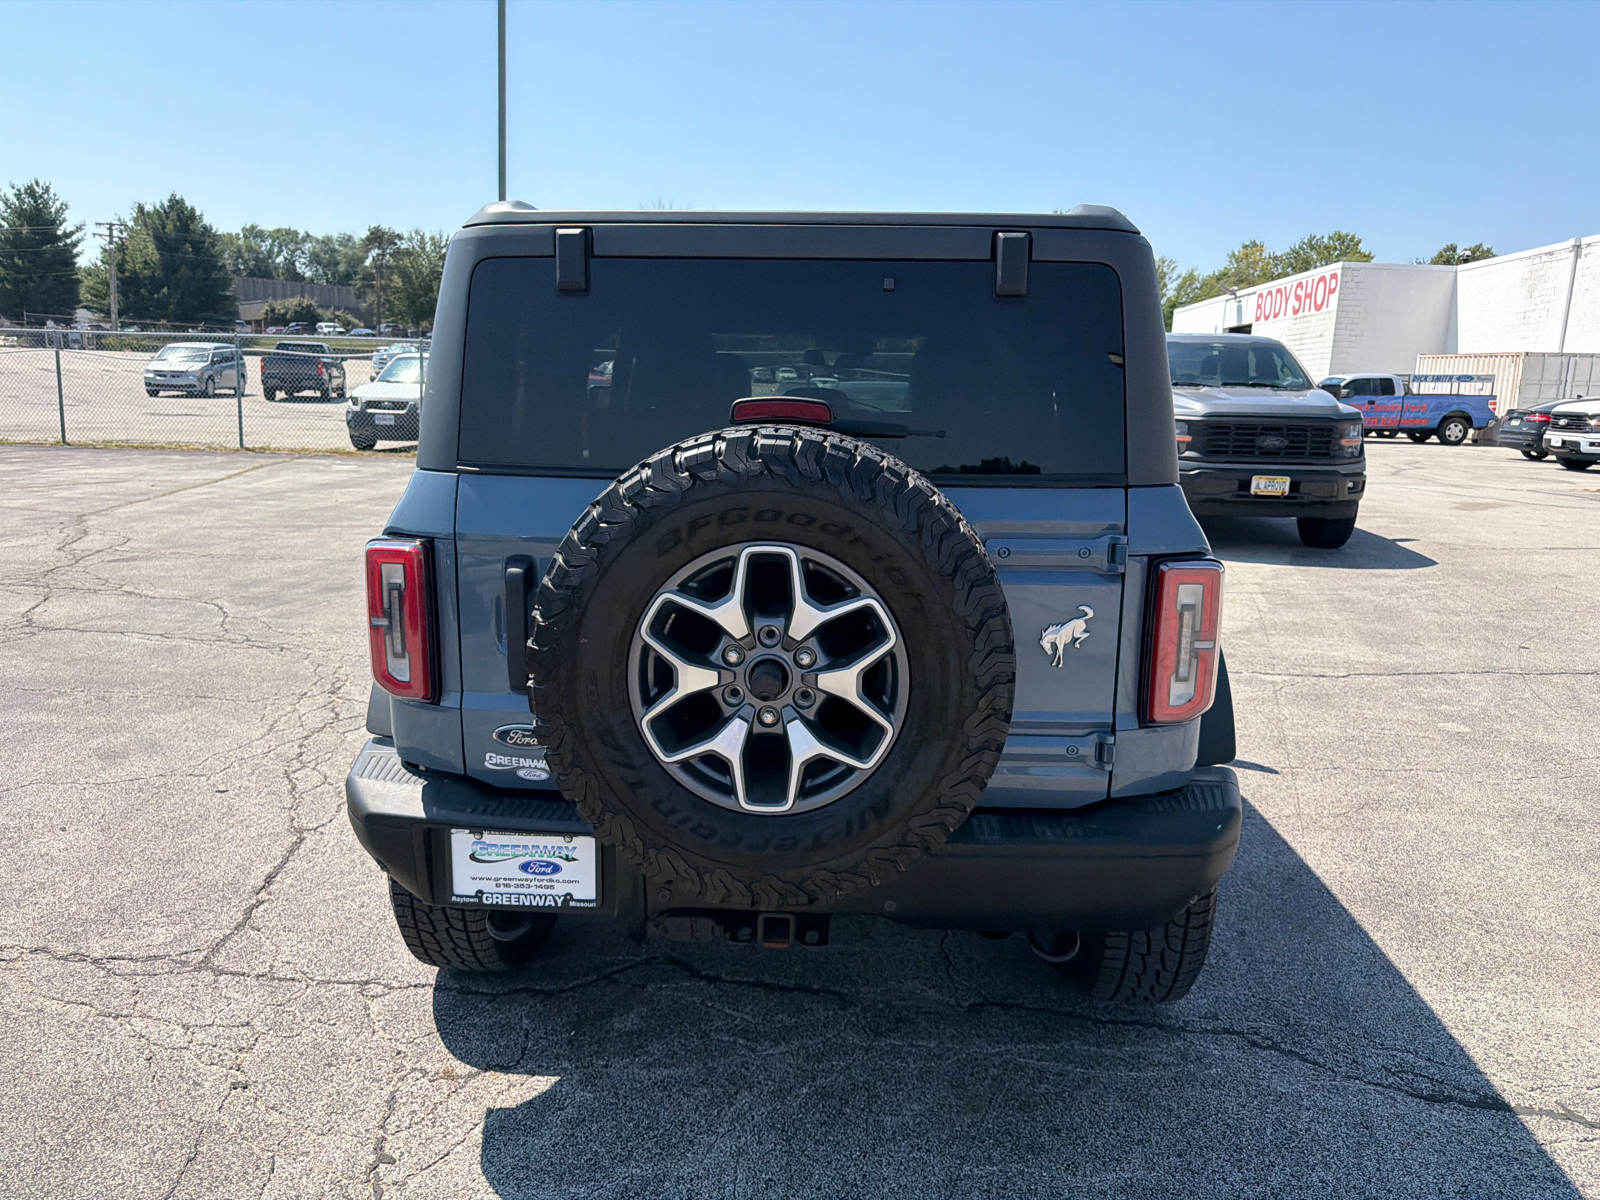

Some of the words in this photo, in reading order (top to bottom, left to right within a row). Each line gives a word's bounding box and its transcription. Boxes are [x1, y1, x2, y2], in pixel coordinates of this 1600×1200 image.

[1404, 403, 1427, 412] Ford
[485, 752, 550, 771] GREENWA
[471, 840, 577, 859] GREENWAY
[527, 861, 554, 874] Ford
[470, 875, 580, 885] www.greenwayfordkc.com
[451, 895, 479, 903] Raytown
[482, 892, 565, 907] GREENWAY
[569, 900, 597, 908] Missouri
